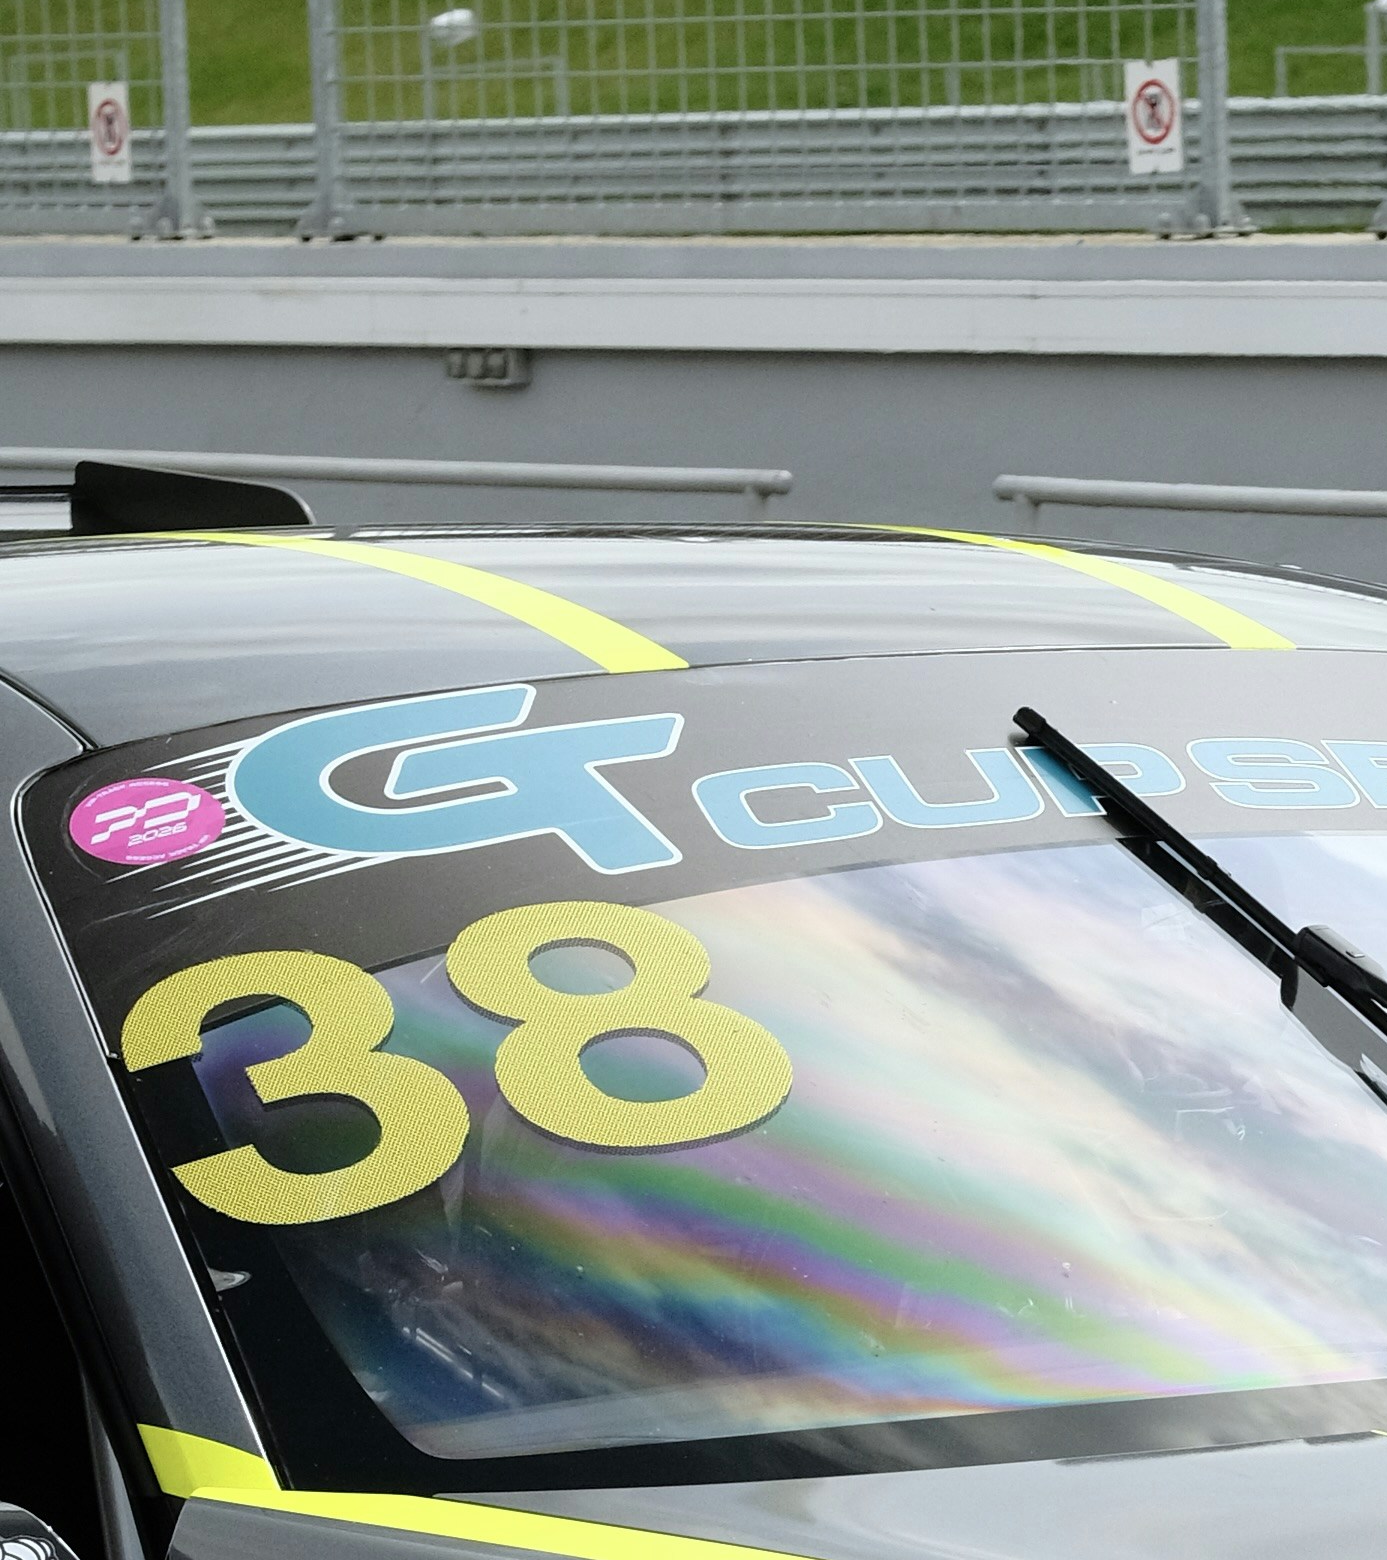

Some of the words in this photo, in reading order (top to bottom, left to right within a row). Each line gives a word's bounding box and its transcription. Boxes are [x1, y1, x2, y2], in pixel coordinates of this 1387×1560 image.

[127, 821, 188, 848] 2026
[225, 683, 686, 875] GT
[121, 899, 794, 1225] 38
